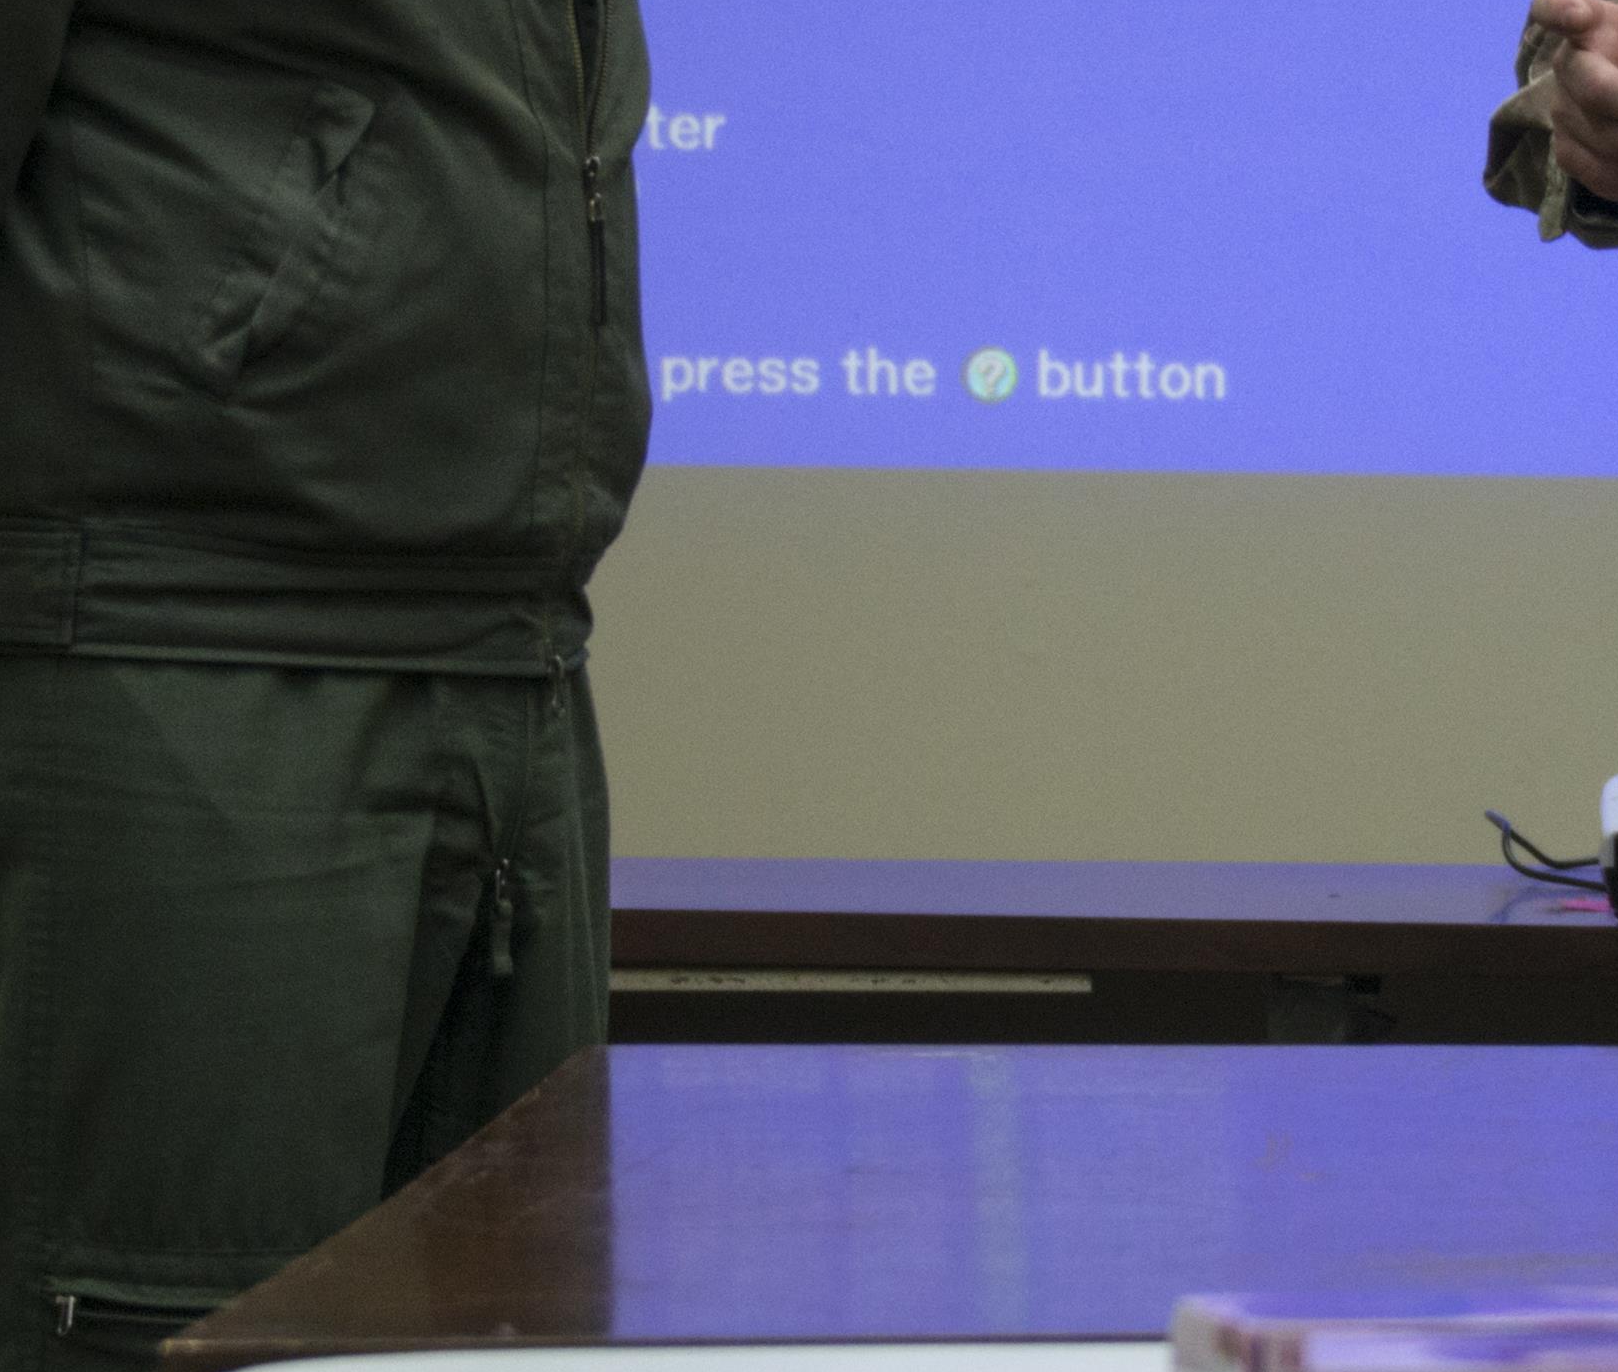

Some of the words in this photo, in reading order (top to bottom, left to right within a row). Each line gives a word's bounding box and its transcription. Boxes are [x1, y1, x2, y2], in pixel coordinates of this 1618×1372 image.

[661, 355, 820, 400] press
[843, 348, 937, 396] the
[1038, 350, 1226, 400] button
